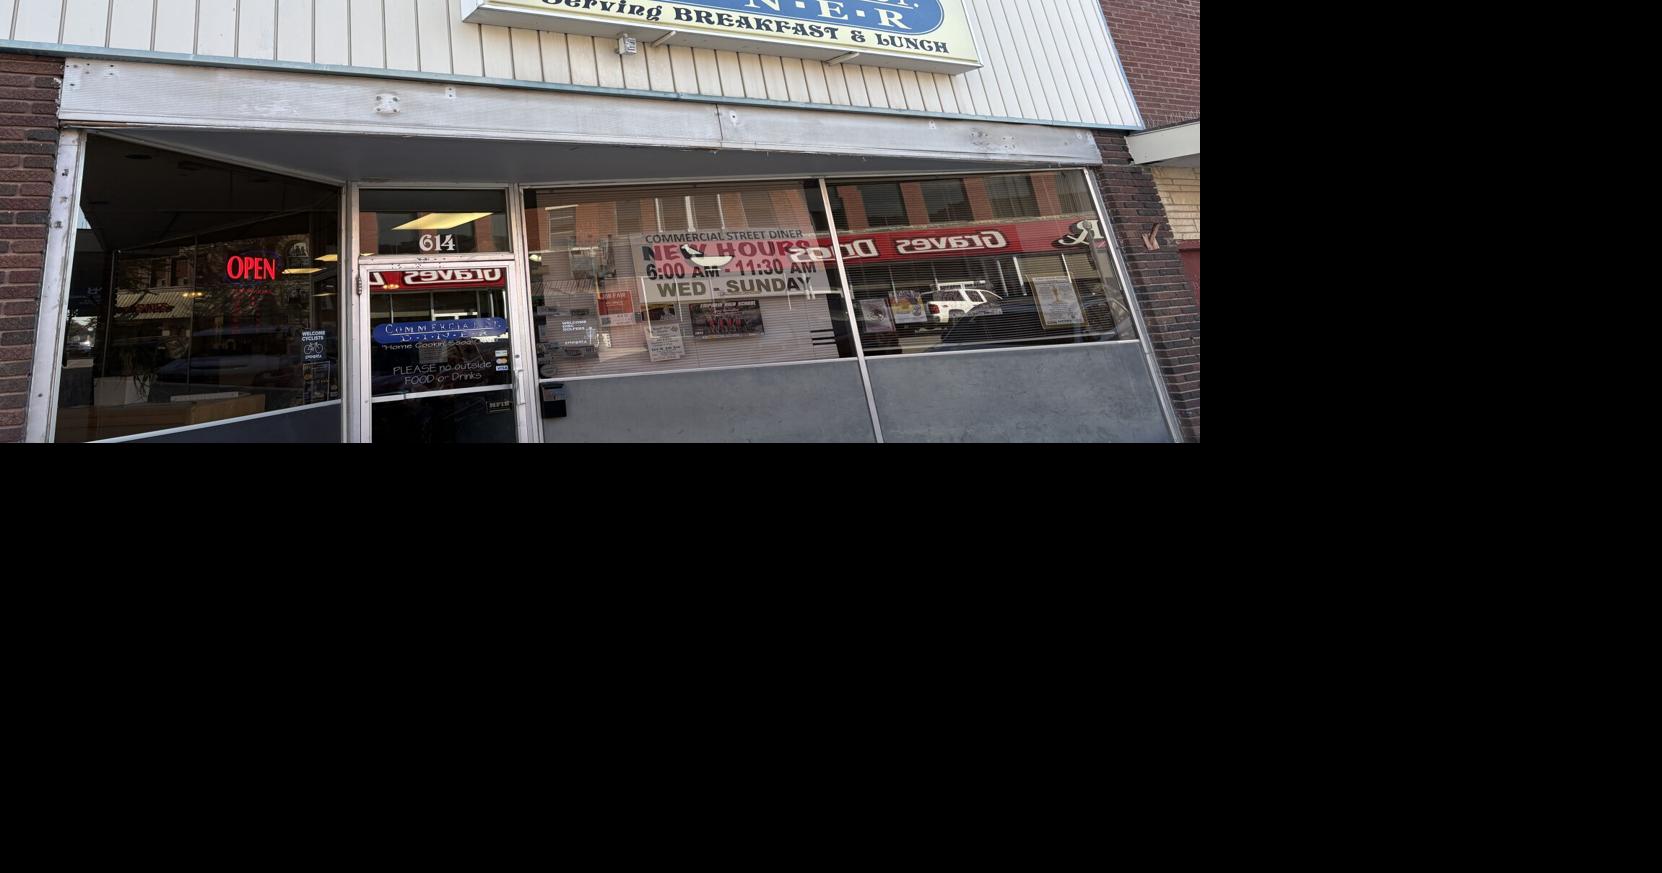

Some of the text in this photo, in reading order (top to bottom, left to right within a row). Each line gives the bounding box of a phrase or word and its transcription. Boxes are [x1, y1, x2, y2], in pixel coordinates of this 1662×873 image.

[542, 0, 950, 53] erving BREAKFAST & LUNCH
[419, 234, 456, 251] 614
[645, 230, 803, 243] COMMERCIAL STREET DINER
[642, 241, 810, 261] NEW HOURS
[227, 255, 276, 280] OPEN
[646, 263, 685, 280] 6:00
[692, 265, 720, 278] AM
[736, 259, 783, 276] 11:30
[790, 262, 817, 273] AM
[657, 281, 706, 297] WED
[726, 277, 811, 293] SUNDAY
[393, 364, 437, 375] PLEASE
[455, 360, 492, 368] outside
[405, 374, 435, 385] FOOD
[452, 371, 482, 381] Drinks
